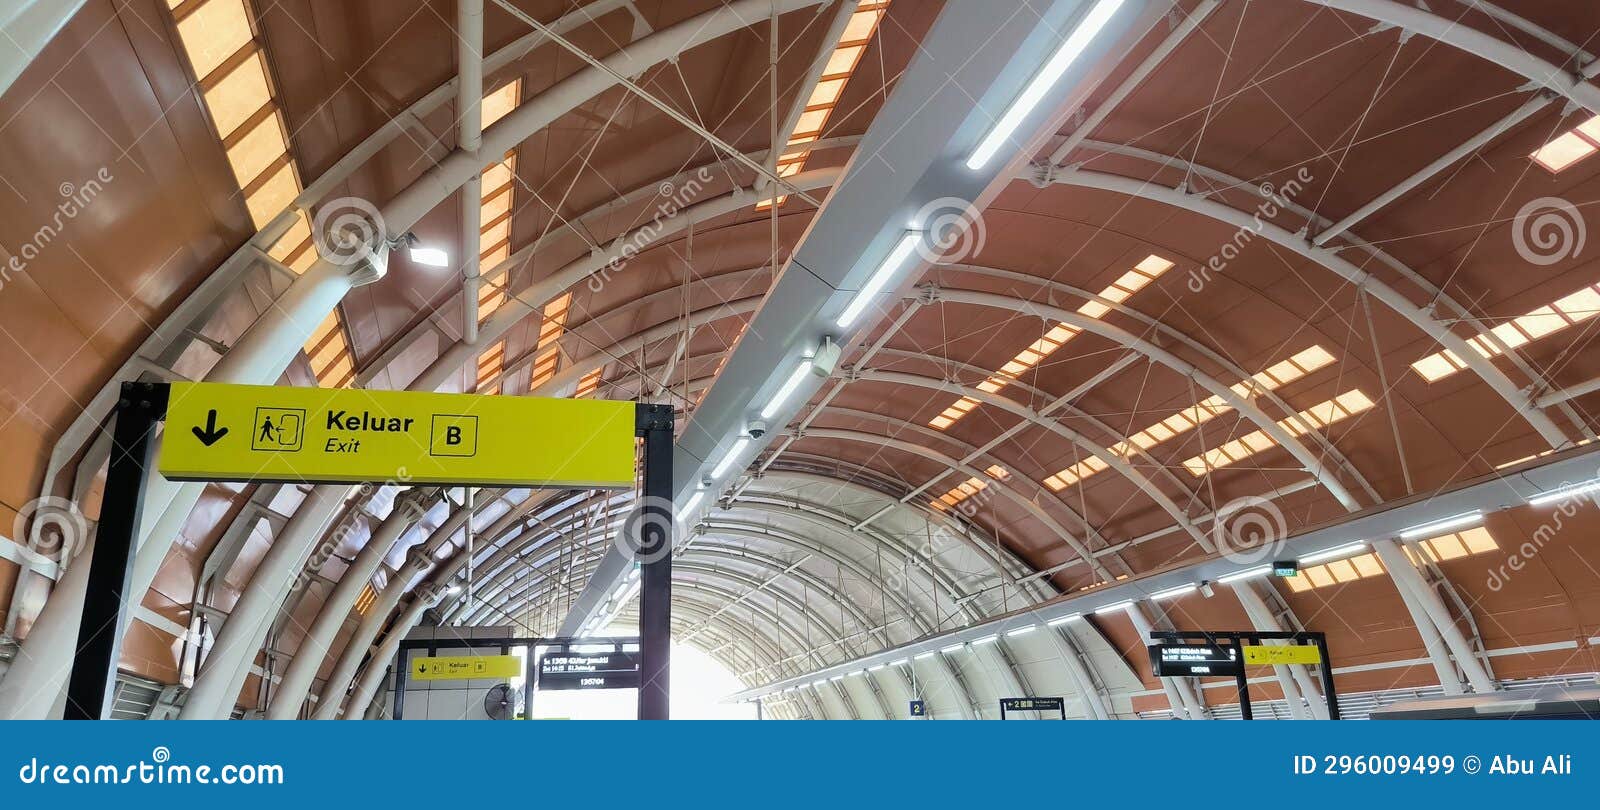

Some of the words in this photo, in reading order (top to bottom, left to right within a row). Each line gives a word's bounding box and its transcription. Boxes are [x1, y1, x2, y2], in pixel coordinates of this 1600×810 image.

[326, 410, 414, 432] Keluar
[446, 426, 462, 445] B
[324, 438, 361, 453] Exit
[913, 704, 920, 713] 2
